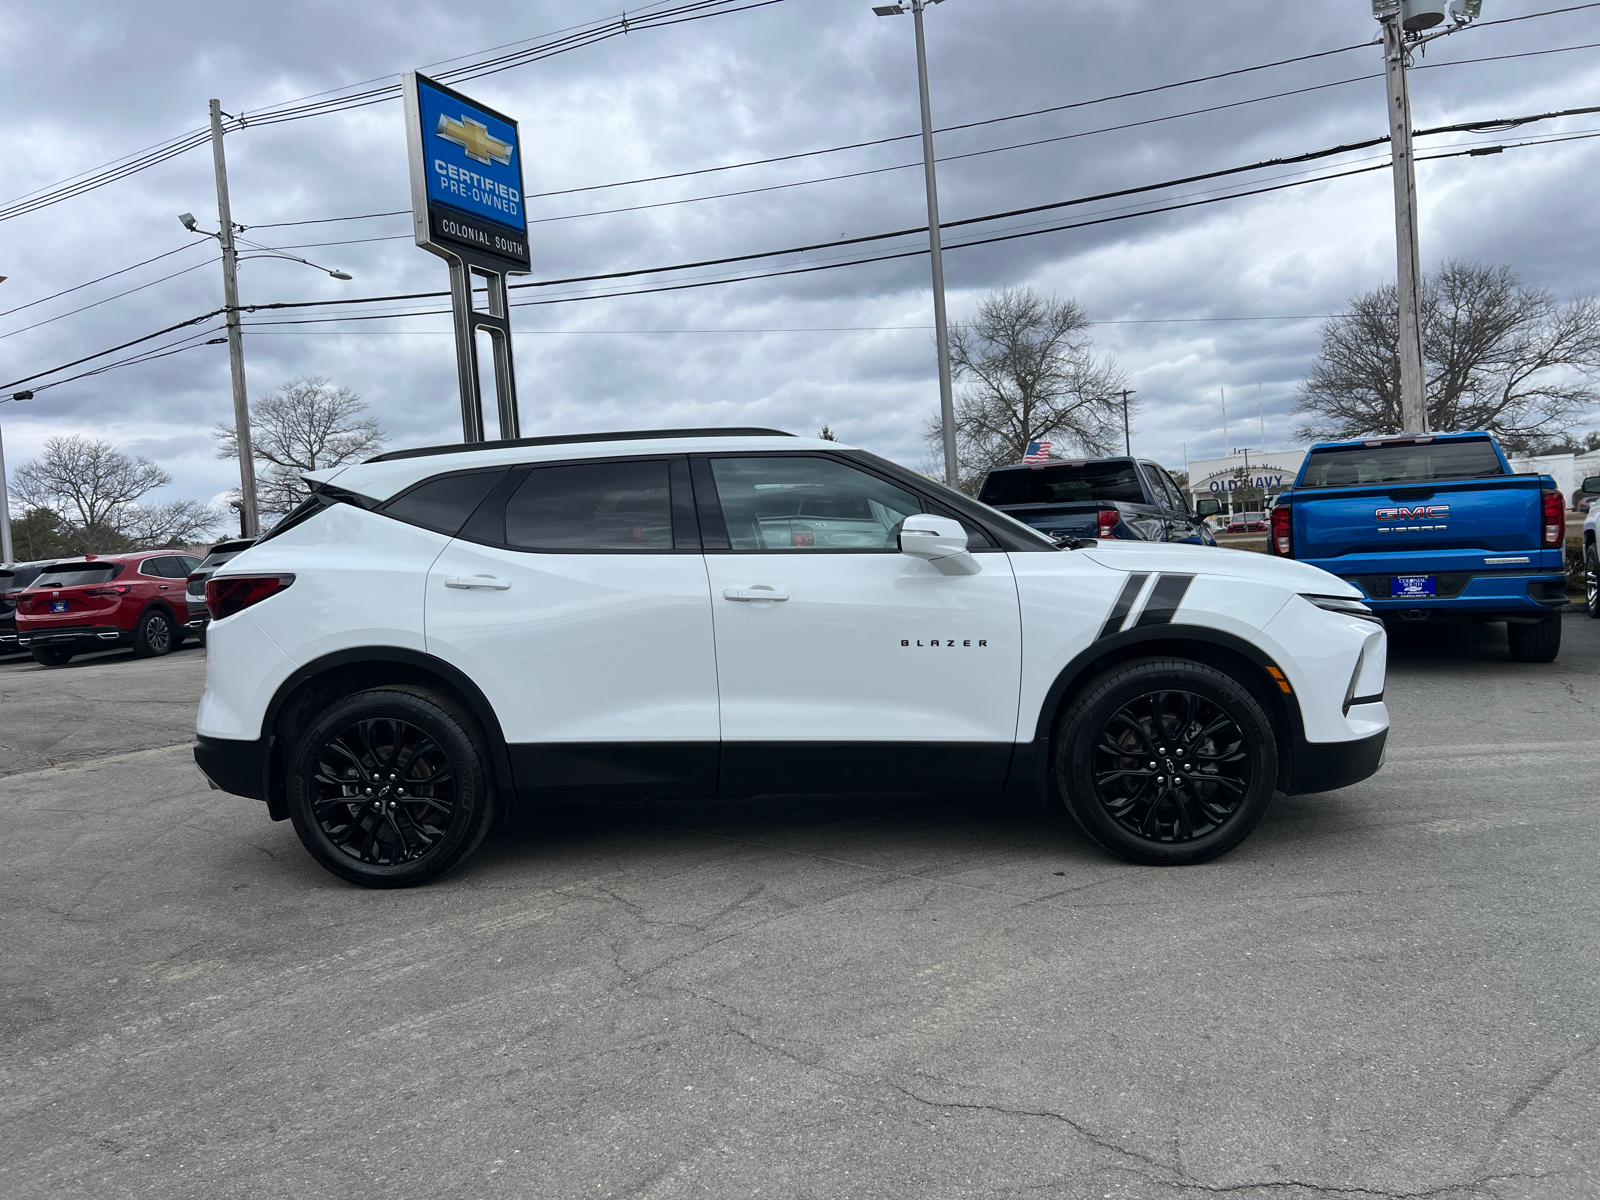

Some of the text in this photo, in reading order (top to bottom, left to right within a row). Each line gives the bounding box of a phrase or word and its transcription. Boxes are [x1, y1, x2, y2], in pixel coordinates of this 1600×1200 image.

[434, 159, 519, 202] CERTIFIED
[440, 171, 518, 215] PRE-OWNED
[442, 219, 523, 256] COLONIAL SOUTH
[1209, 474, 1283, 494] OLD NAVY
[1375, 505, 1450, 521] GMC
[1377, 525, 1447, 533] SIERRA
[900, 639, 988, 647] BLAZER
[457, 753, 471, 809] MICHELIN
